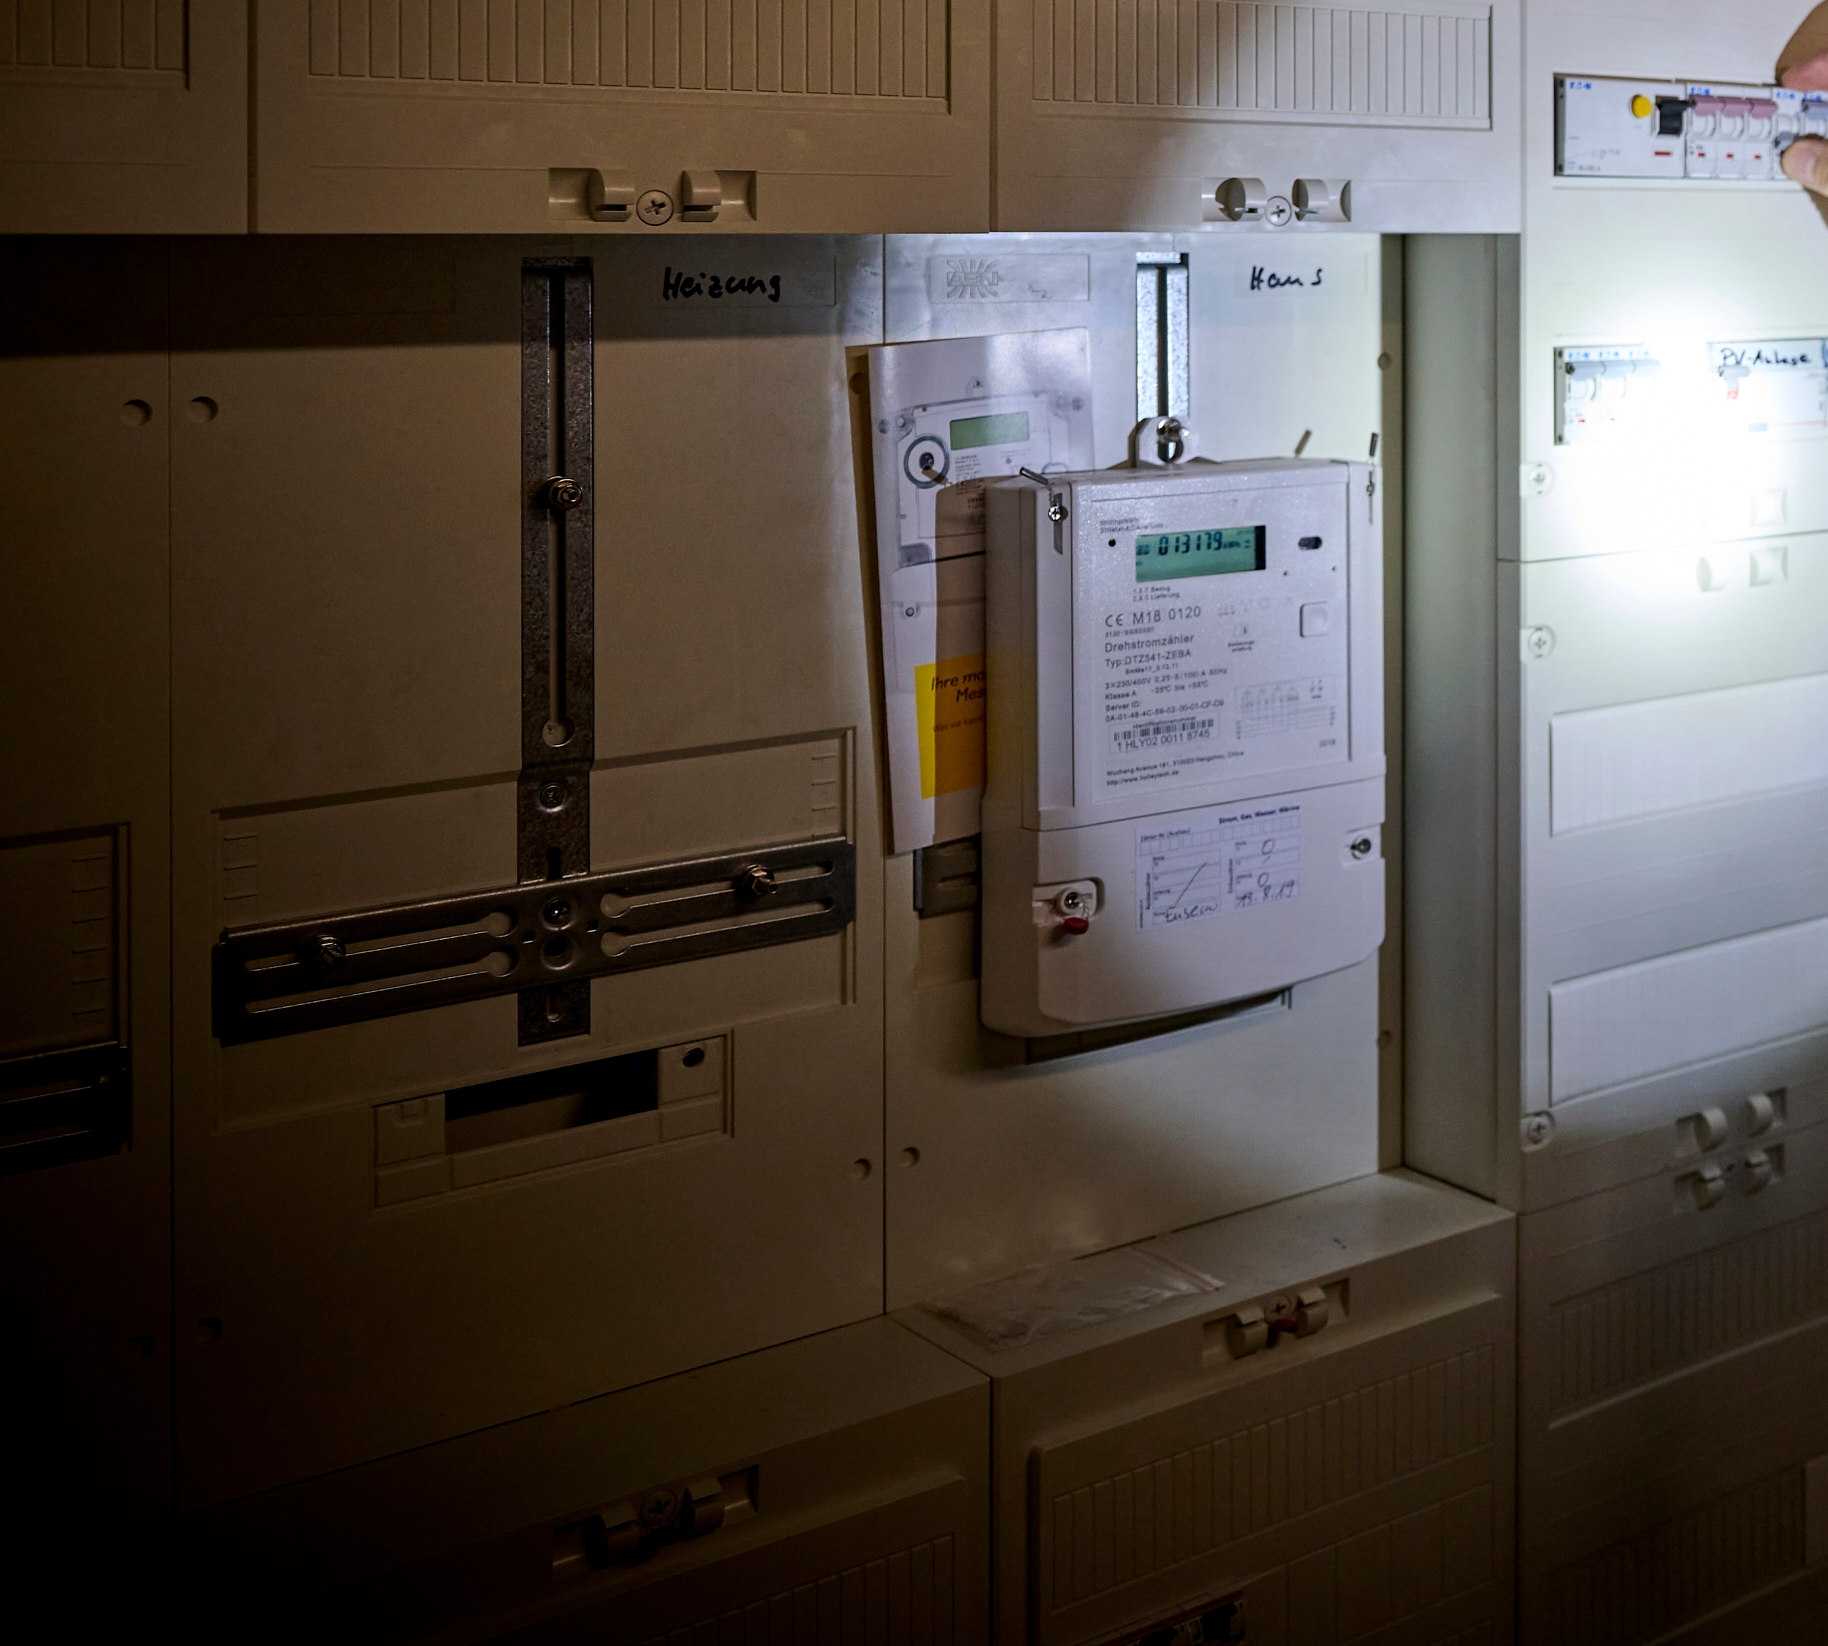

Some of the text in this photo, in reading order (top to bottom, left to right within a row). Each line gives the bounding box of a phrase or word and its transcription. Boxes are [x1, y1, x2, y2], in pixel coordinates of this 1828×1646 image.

[663, 267, 780, 302] Heizung
[1132, 610, 1161, 625] M18
[1168, 606, 1201, 620] 0120
[1105, 634, 1194, 653] Drehstromzähler
[931, 676, 959, 691] Ihre
[1105, 703, 1130, 712] Server
[1125, 737, 1158, 750] HLY02
[1161, 734, 1183, 745] 0011
